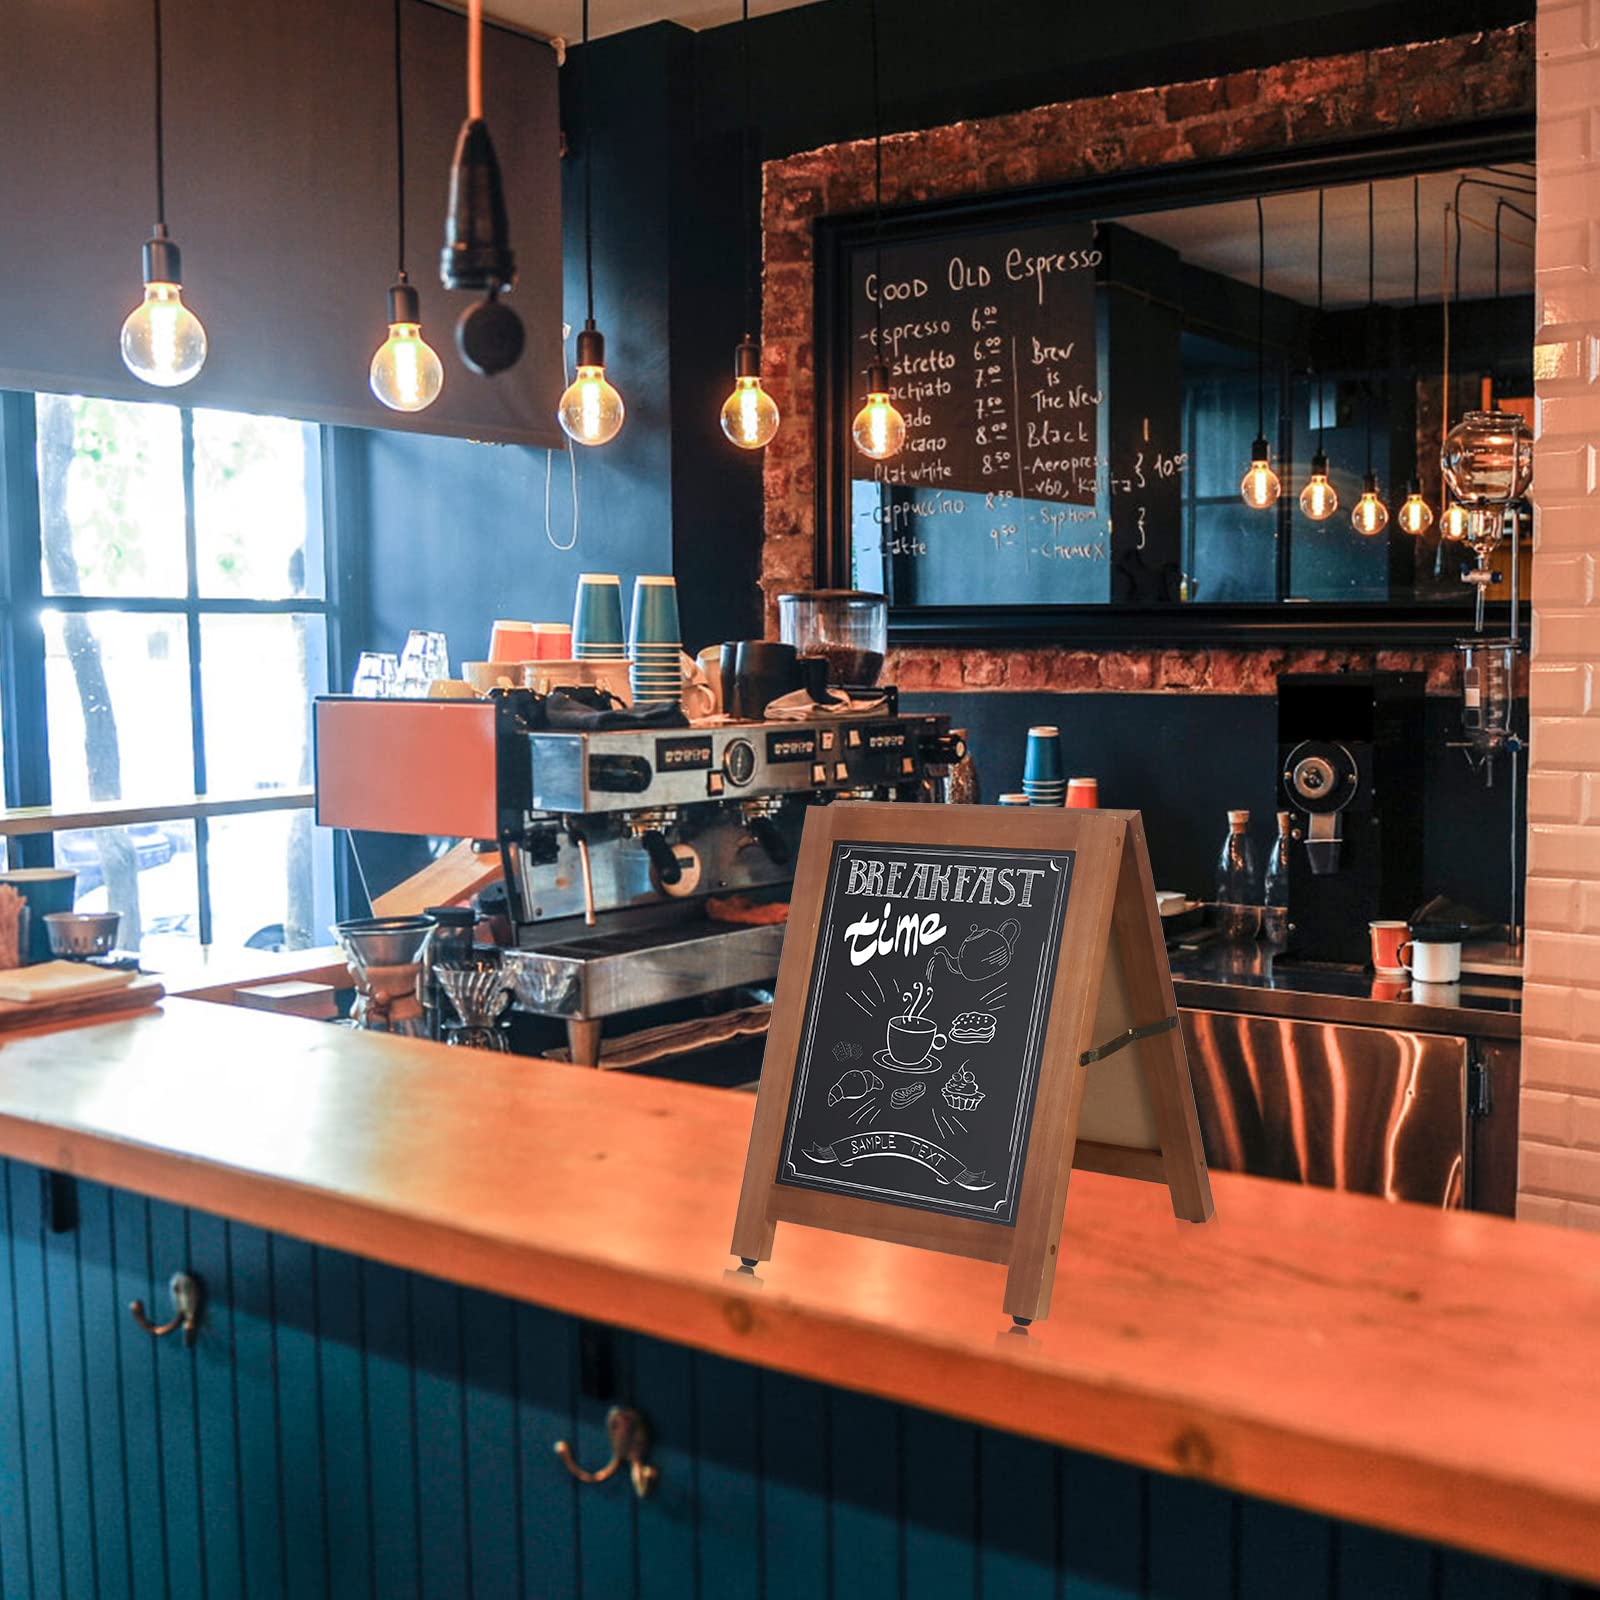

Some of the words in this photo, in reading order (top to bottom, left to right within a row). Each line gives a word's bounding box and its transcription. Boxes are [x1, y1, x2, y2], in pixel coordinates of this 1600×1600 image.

[949, 257, 991, 290] OLD
[1046, 367, 1062, 387] is
[1068, 384, 1105, 409] New
[1027, 420, 1089, 448] Black
[845, 859, 1046, 908] BREAKFAST
[843, 902, 948, 967] time
[850, 1134, 898, 1156] SAMPLE
[911, 1140, 947, 1167] TEXT
